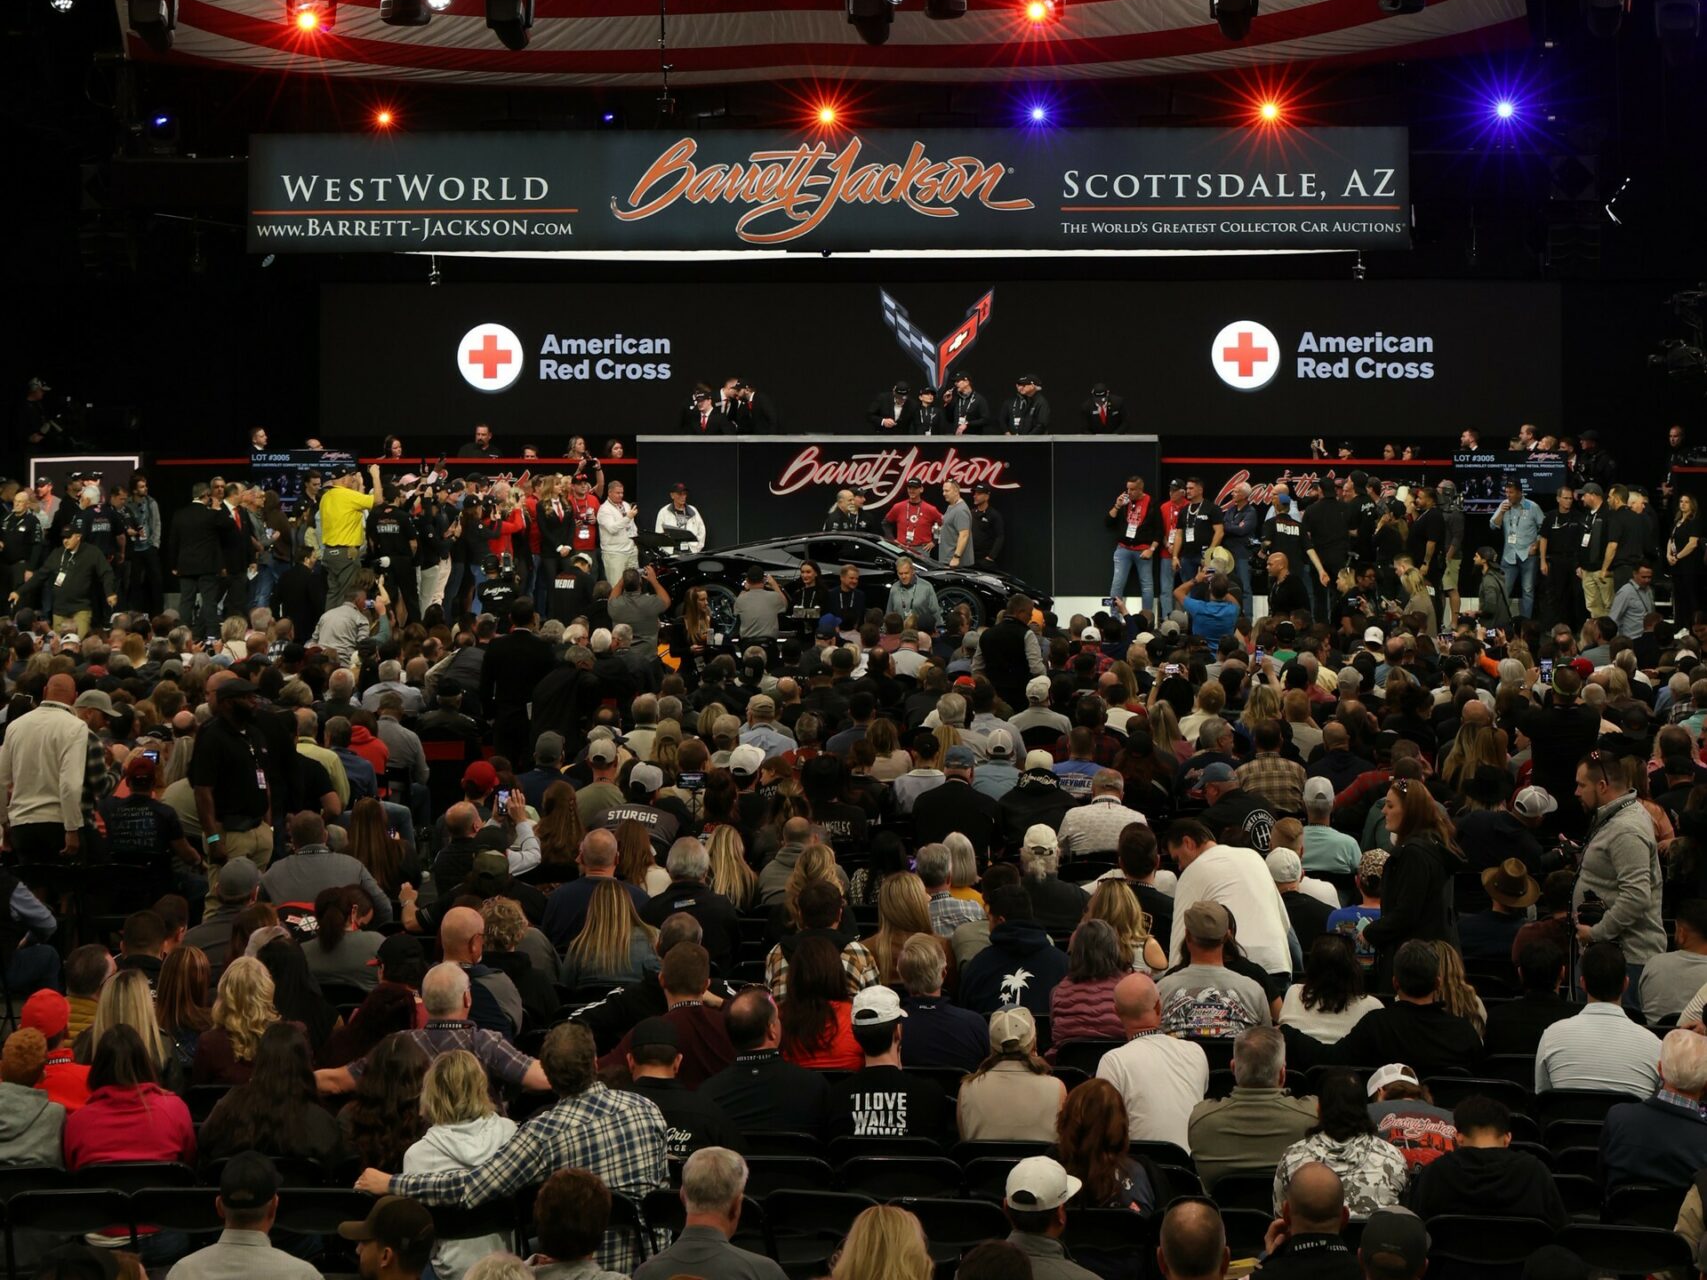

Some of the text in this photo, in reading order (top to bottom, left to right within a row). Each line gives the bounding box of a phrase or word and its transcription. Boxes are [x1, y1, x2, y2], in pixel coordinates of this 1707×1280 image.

[281, 174, 549, 202] WESTWORLD
[610, 136, 1036, 244] Barrett-Jackson
[1063, 168, 1396, 200] SCOTTSDALE, AZ
[1061, 221, 1401, 234] THE WORLD'S GREATEST COLLECTOR CAR AUCTIONS
[540, 333, 671, 355] American
[1297, 331, 1434, 353] American
[539, 357, 672, 380] Red Cross
[1296, 356, 1435, 379] Red Cross
[1454, 454, 1495, 462] LOT #3005
[769, 445, 1021, 511] Barrett-Jackson
[554, 579, 575, 589] MEDIA
[1060, 779, 1091, 788] HEVROLE
[608, 810, 658, 824] STURGIS
[865, 1092, 907, 1110] LOVE
[852, 1111, 907, 1128] WALLS
[667, 1127, 692, 1144] Grip
